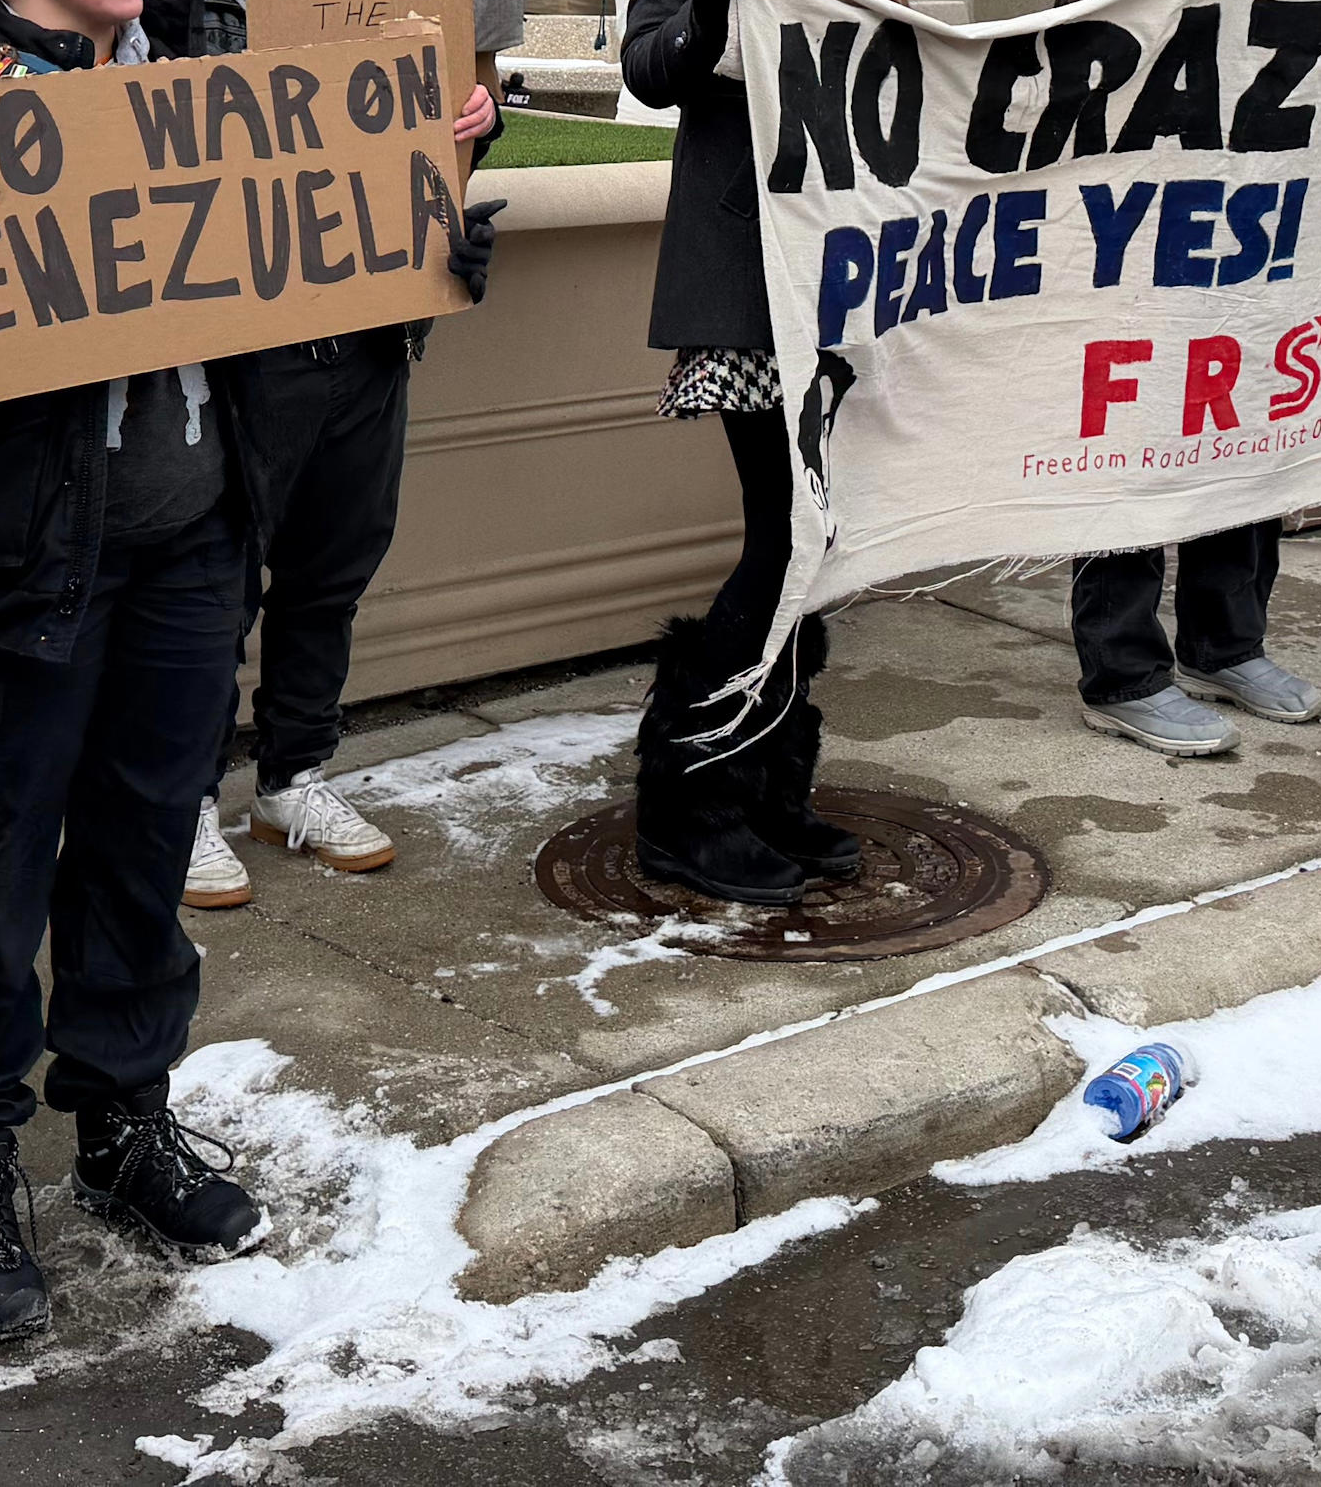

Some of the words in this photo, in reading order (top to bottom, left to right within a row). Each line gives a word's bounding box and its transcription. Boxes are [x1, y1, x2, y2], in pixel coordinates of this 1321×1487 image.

[312, 1, 390, 31] THE
[125, 64, 324, 171] WAR
[768, 19, 924, 193] NO
[817, 188, 1048, 348] PEACE
[1079, 177, 1310, 289] YES!
[1023, 446, 1126, 478] Freedom
[1142, 440, 1201, 469] Road
[1211, 425, 1308, 460] Socialist
